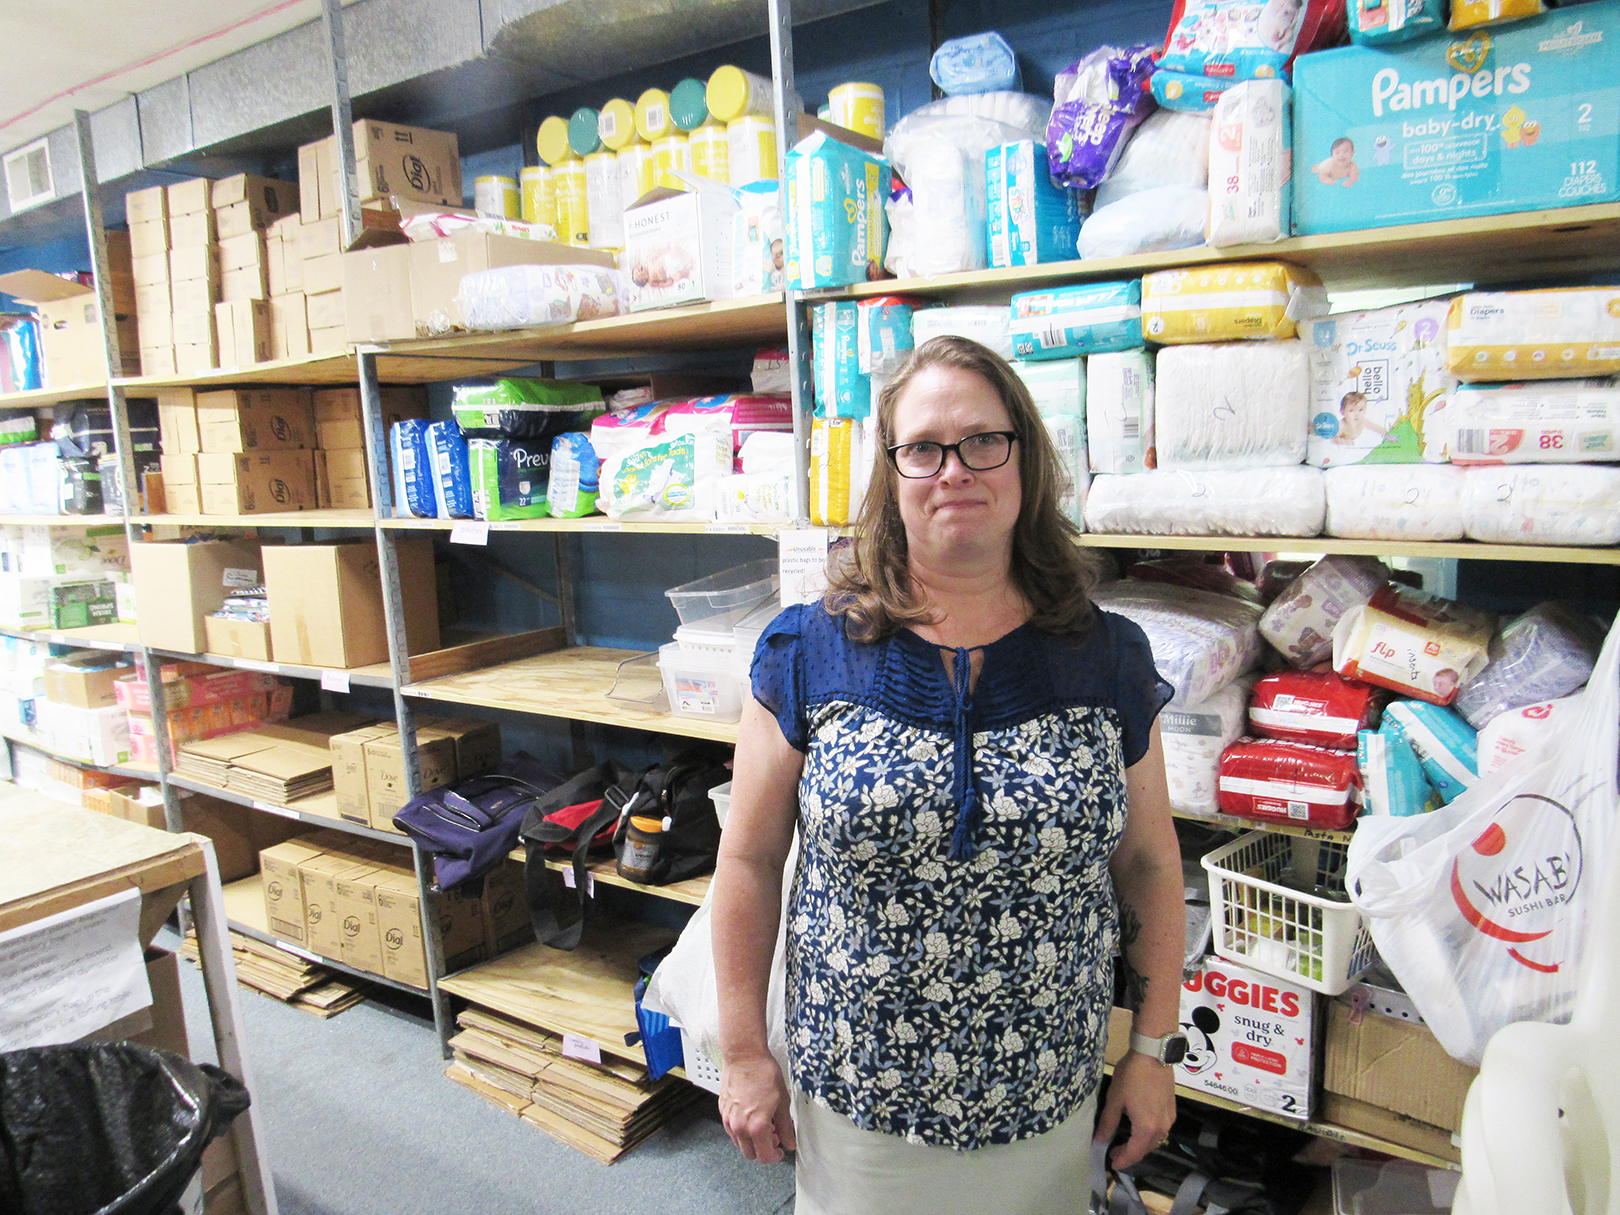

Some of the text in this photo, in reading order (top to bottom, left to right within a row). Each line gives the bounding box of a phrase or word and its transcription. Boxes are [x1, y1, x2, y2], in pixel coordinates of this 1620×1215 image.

[1371, 63, 1532, 118] Pampers
[1577, 103, 1593, 124] 2
[1402, 111, 1496, 138] baby-dry
[1220, 126, 1236, 143] 2
[409, 155, 425, 191] Dial
[1570, 160, 1597, 176] 112
[1226, 175, 1240, 194] 38
[634, 211, 671, 229] HONEST
[851, 178, 867, 266] Pampers
[677, 282, 686, 291] 80
[1419, 321, 1432, 336] 2
[1362, 367, 1372, 395] hello
[1373, 366, 1383, 394] bello
[1539, 435, 1564, 449] 38
[1162, 713, 1197, 726] Millie
[1167, 725, 1191, 733] MOON
[268, 882, 283, 898] Dial
[1507, 893, 1566, 918] SUSHI BAR
[343, 918, 361, 933] Dial
[385, 931, 403, 946] Dial
[1234, 1015, 1284, 1036] snug &
[1246, 1029, 1272, 1047] dry
[1250, 1056, 1282, 1068] PROTECTION
[1281, 1094, 1297, 1113] 2
